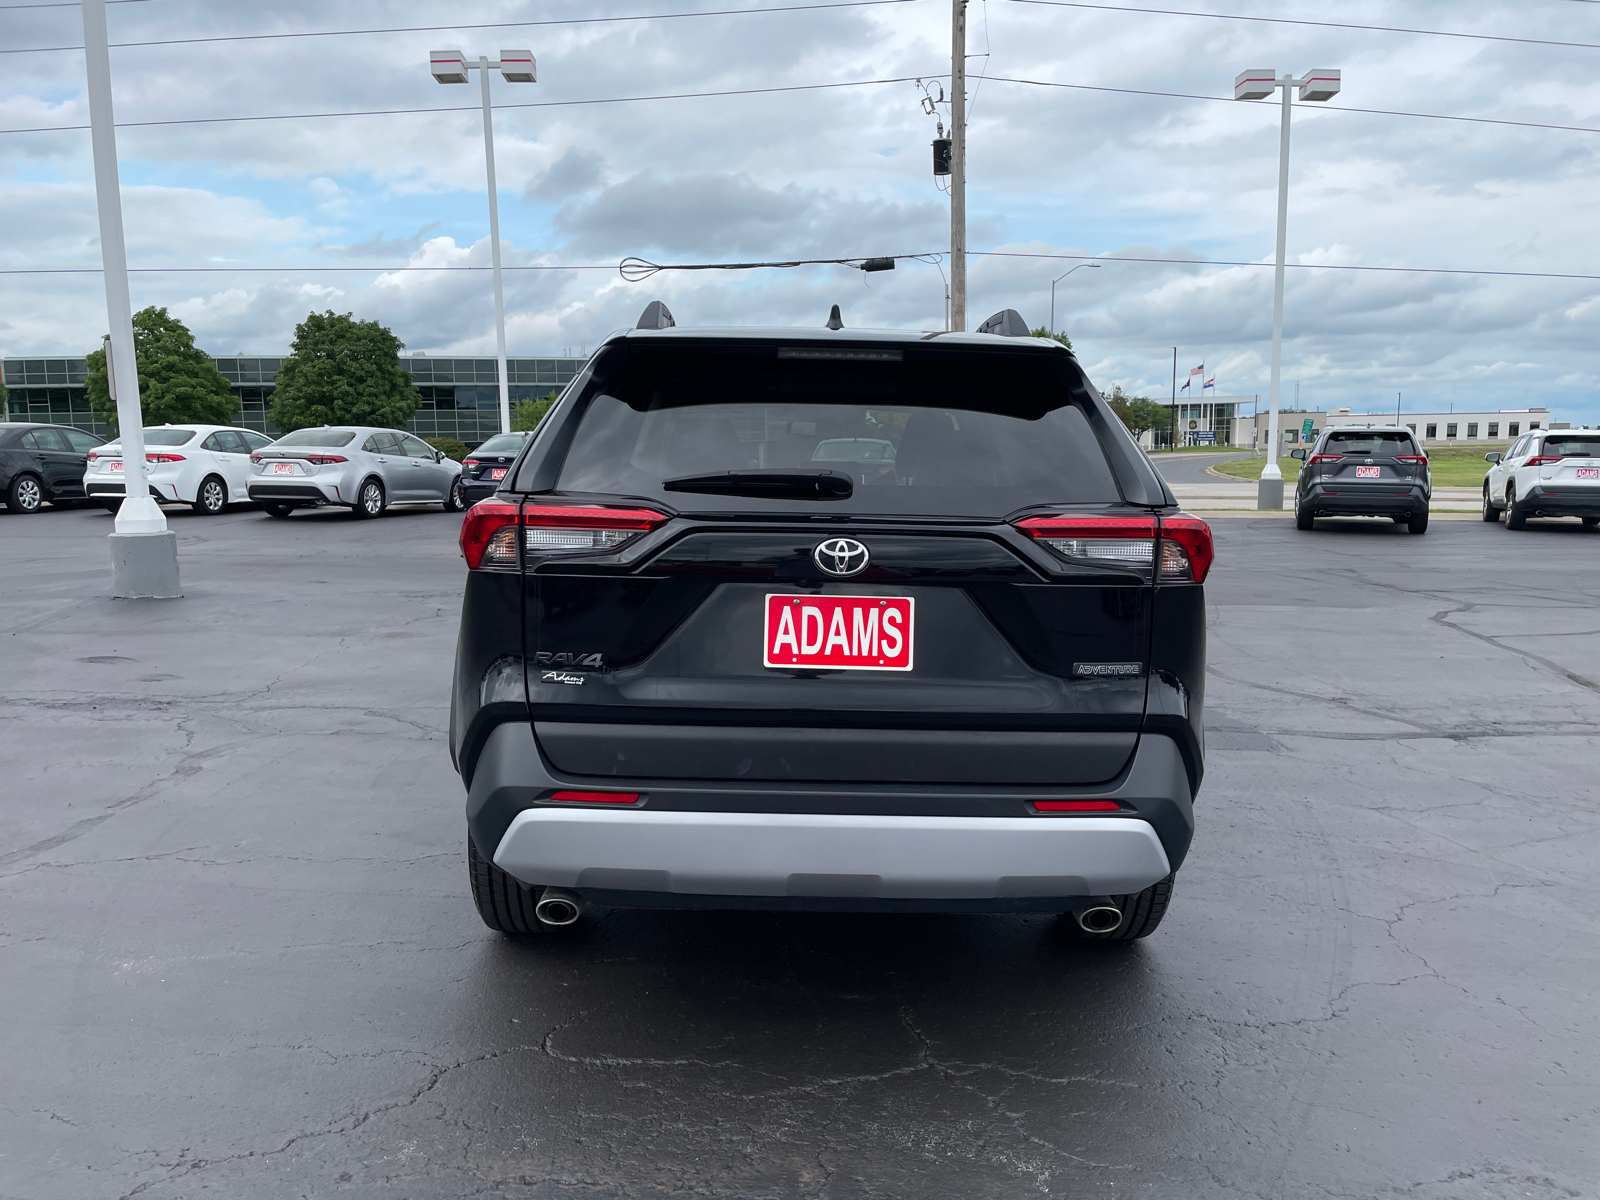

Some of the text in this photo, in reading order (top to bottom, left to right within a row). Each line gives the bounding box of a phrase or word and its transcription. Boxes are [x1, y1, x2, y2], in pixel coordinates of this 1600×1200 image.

[1358, 467, 1378, 476] ADAMS
[1577, 469, 1598, 478] ADAMS
[772, 605, 903, 658] ADAMS
[532, 651, 603, 667] RAV4
[1077, 664, 1139, 675] ADVENTURE
[542, 671, 585, 682] Adams
